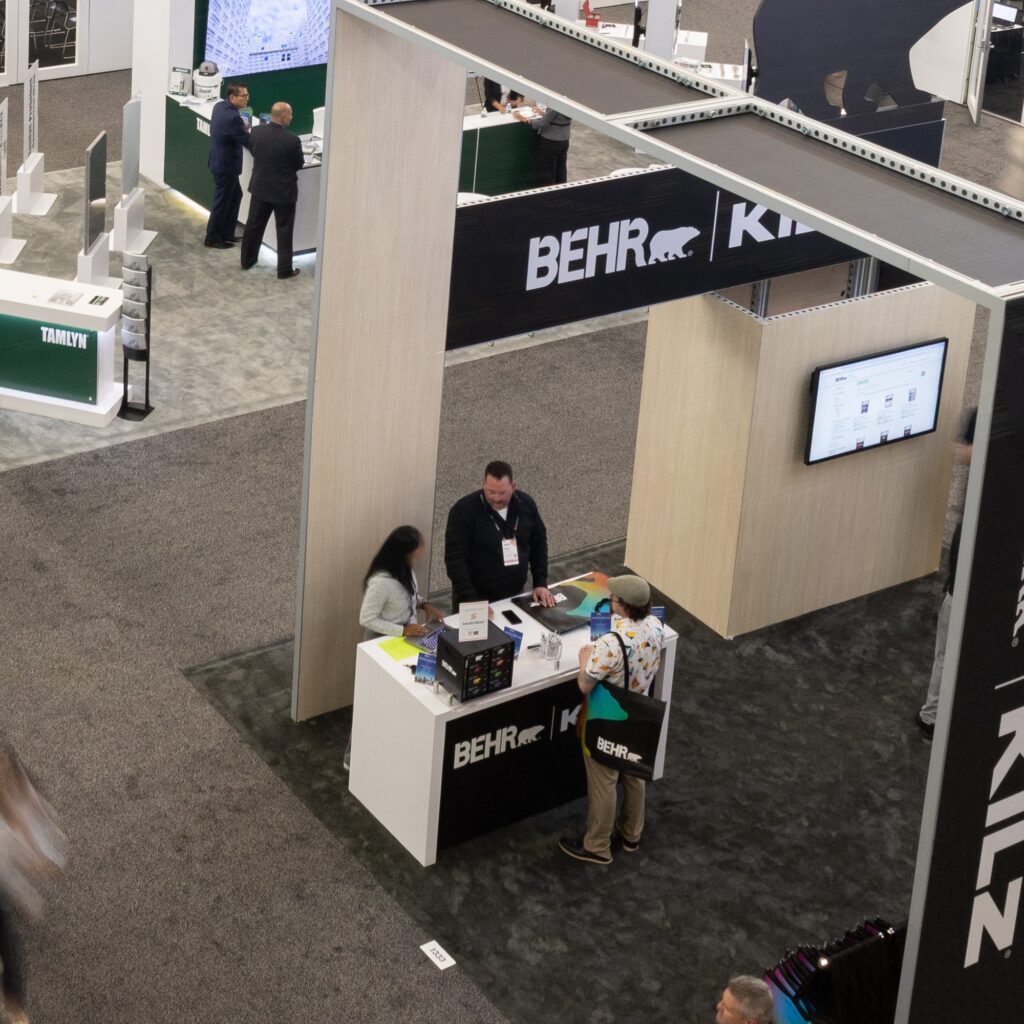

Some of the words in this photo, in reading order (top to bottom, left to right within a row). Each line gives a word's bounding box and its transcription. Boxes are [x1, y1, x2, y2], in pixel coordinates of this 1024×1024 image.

[526, 217, 649, 291] BEHR
[728, 202, 816, 249] KI
[40, 326, 88, 349] TAMLYN
[453, 725, 518, 769] BEHR
[597, 736, 628, 760] BEHR
